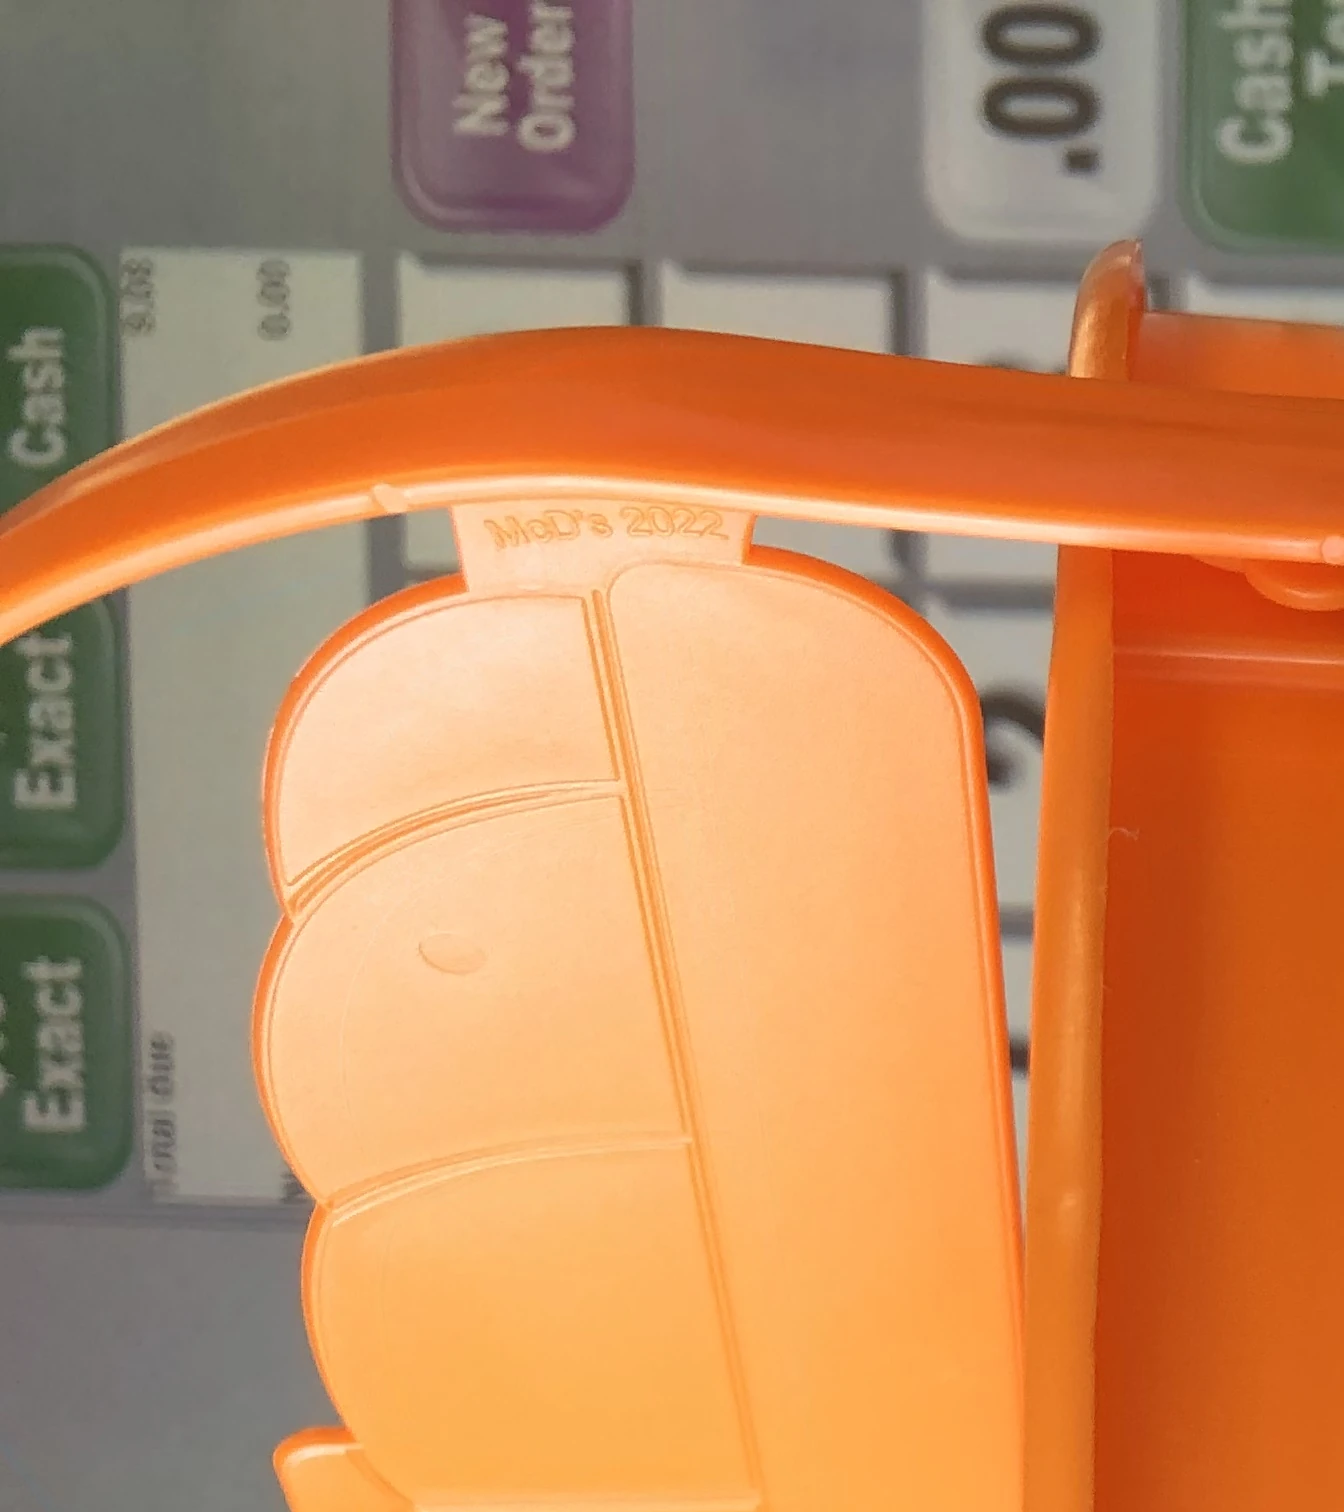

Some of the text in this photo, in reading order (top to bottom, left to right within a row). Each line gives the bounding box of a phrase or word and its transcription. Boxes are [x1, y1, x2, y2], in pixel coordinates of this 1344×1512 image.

[453, 14, 509, 135] New
[516, 0, 575, 151] Order
[982, 3, 1101, 174] .00
[1217, 0, 1293, 164] Cash
[257, 258, 291, 341] 0.00
[8, 327, 66, 466] Cash
[619, 506, 730, 541] 2022
[15, 630, 78, 812] Exact
[22, 956, 85, 1133] Exact
